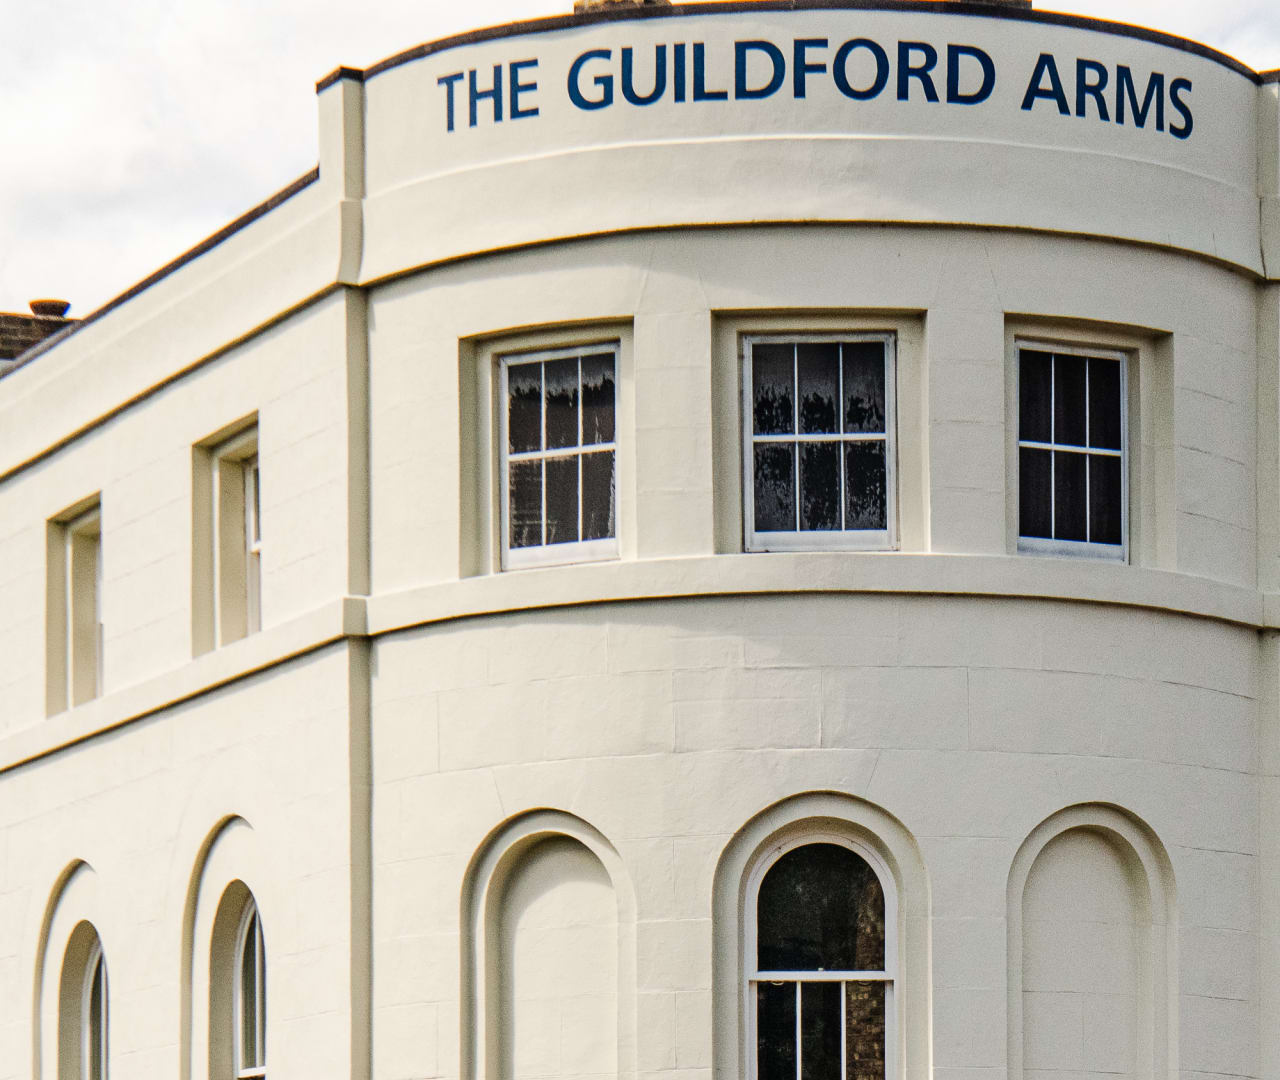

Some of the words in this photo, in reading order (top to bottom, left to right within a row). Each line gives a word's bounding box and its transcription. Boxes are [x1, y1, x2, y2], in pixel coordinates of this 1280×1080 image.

[437, 57, 540, 132] THE
[566, 37, 996, 111] GUILDFORD
[1020, 53, 1194, 140] ARMS
